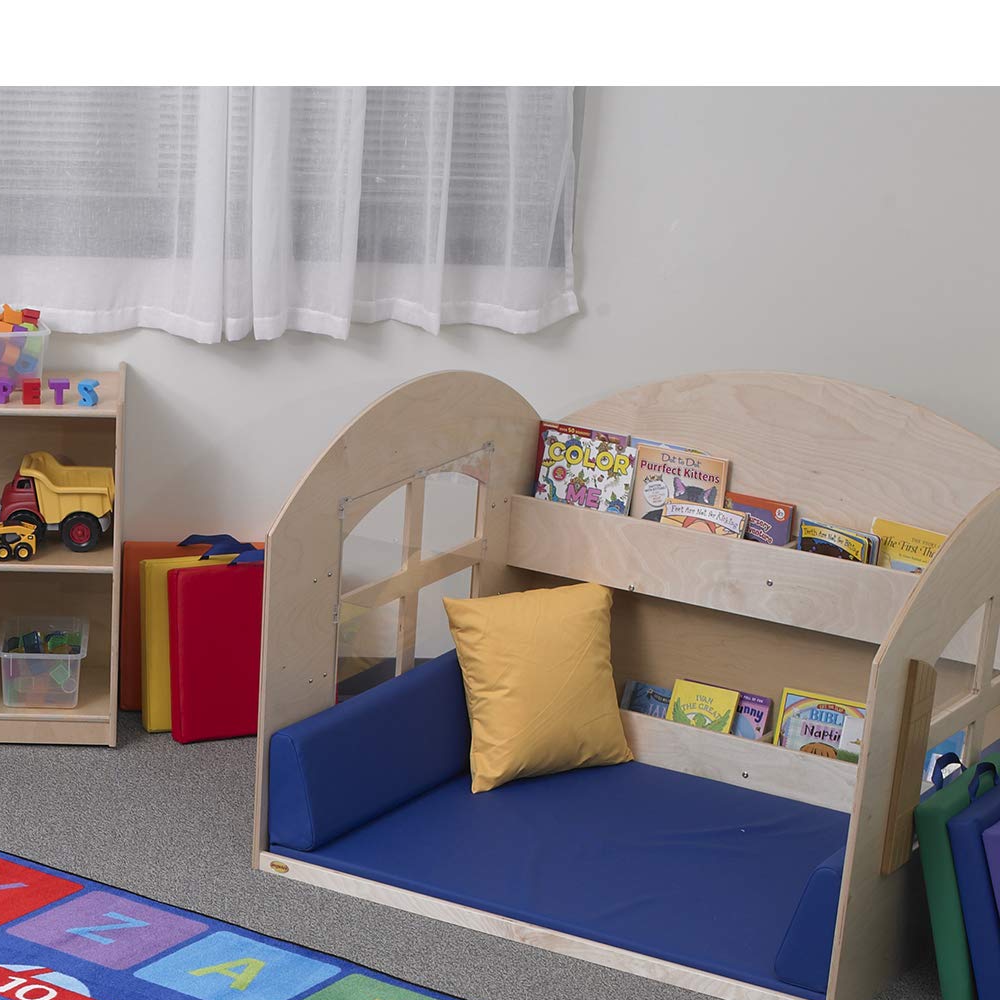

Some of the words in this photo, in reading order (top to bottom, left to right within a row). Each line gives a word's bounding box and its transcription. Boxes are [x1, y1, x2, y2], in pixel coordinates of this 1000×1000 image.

[549, 441, 630, 476] COLOR
[661, 453, 677, 463] Dot
[686, 458, 702, 468] Dot
[640, 460, 681, 475] Purrfect
[683, 468, 720, 484] Kittens
[566, 483, 602, 509] ME
[748, 514, 771, 532] ursery
[883, 536, 898, 548] The
[900, 540, 919, 553] First
[696, 694, 713, 704] IVAN
[681, 703, 696, 712] THE
[698, 703, 721, 719] GREAT
[737, 705, 763, 723] unny
[65, 911, 152, 945] Z
[188, 957, 266, 991] A
